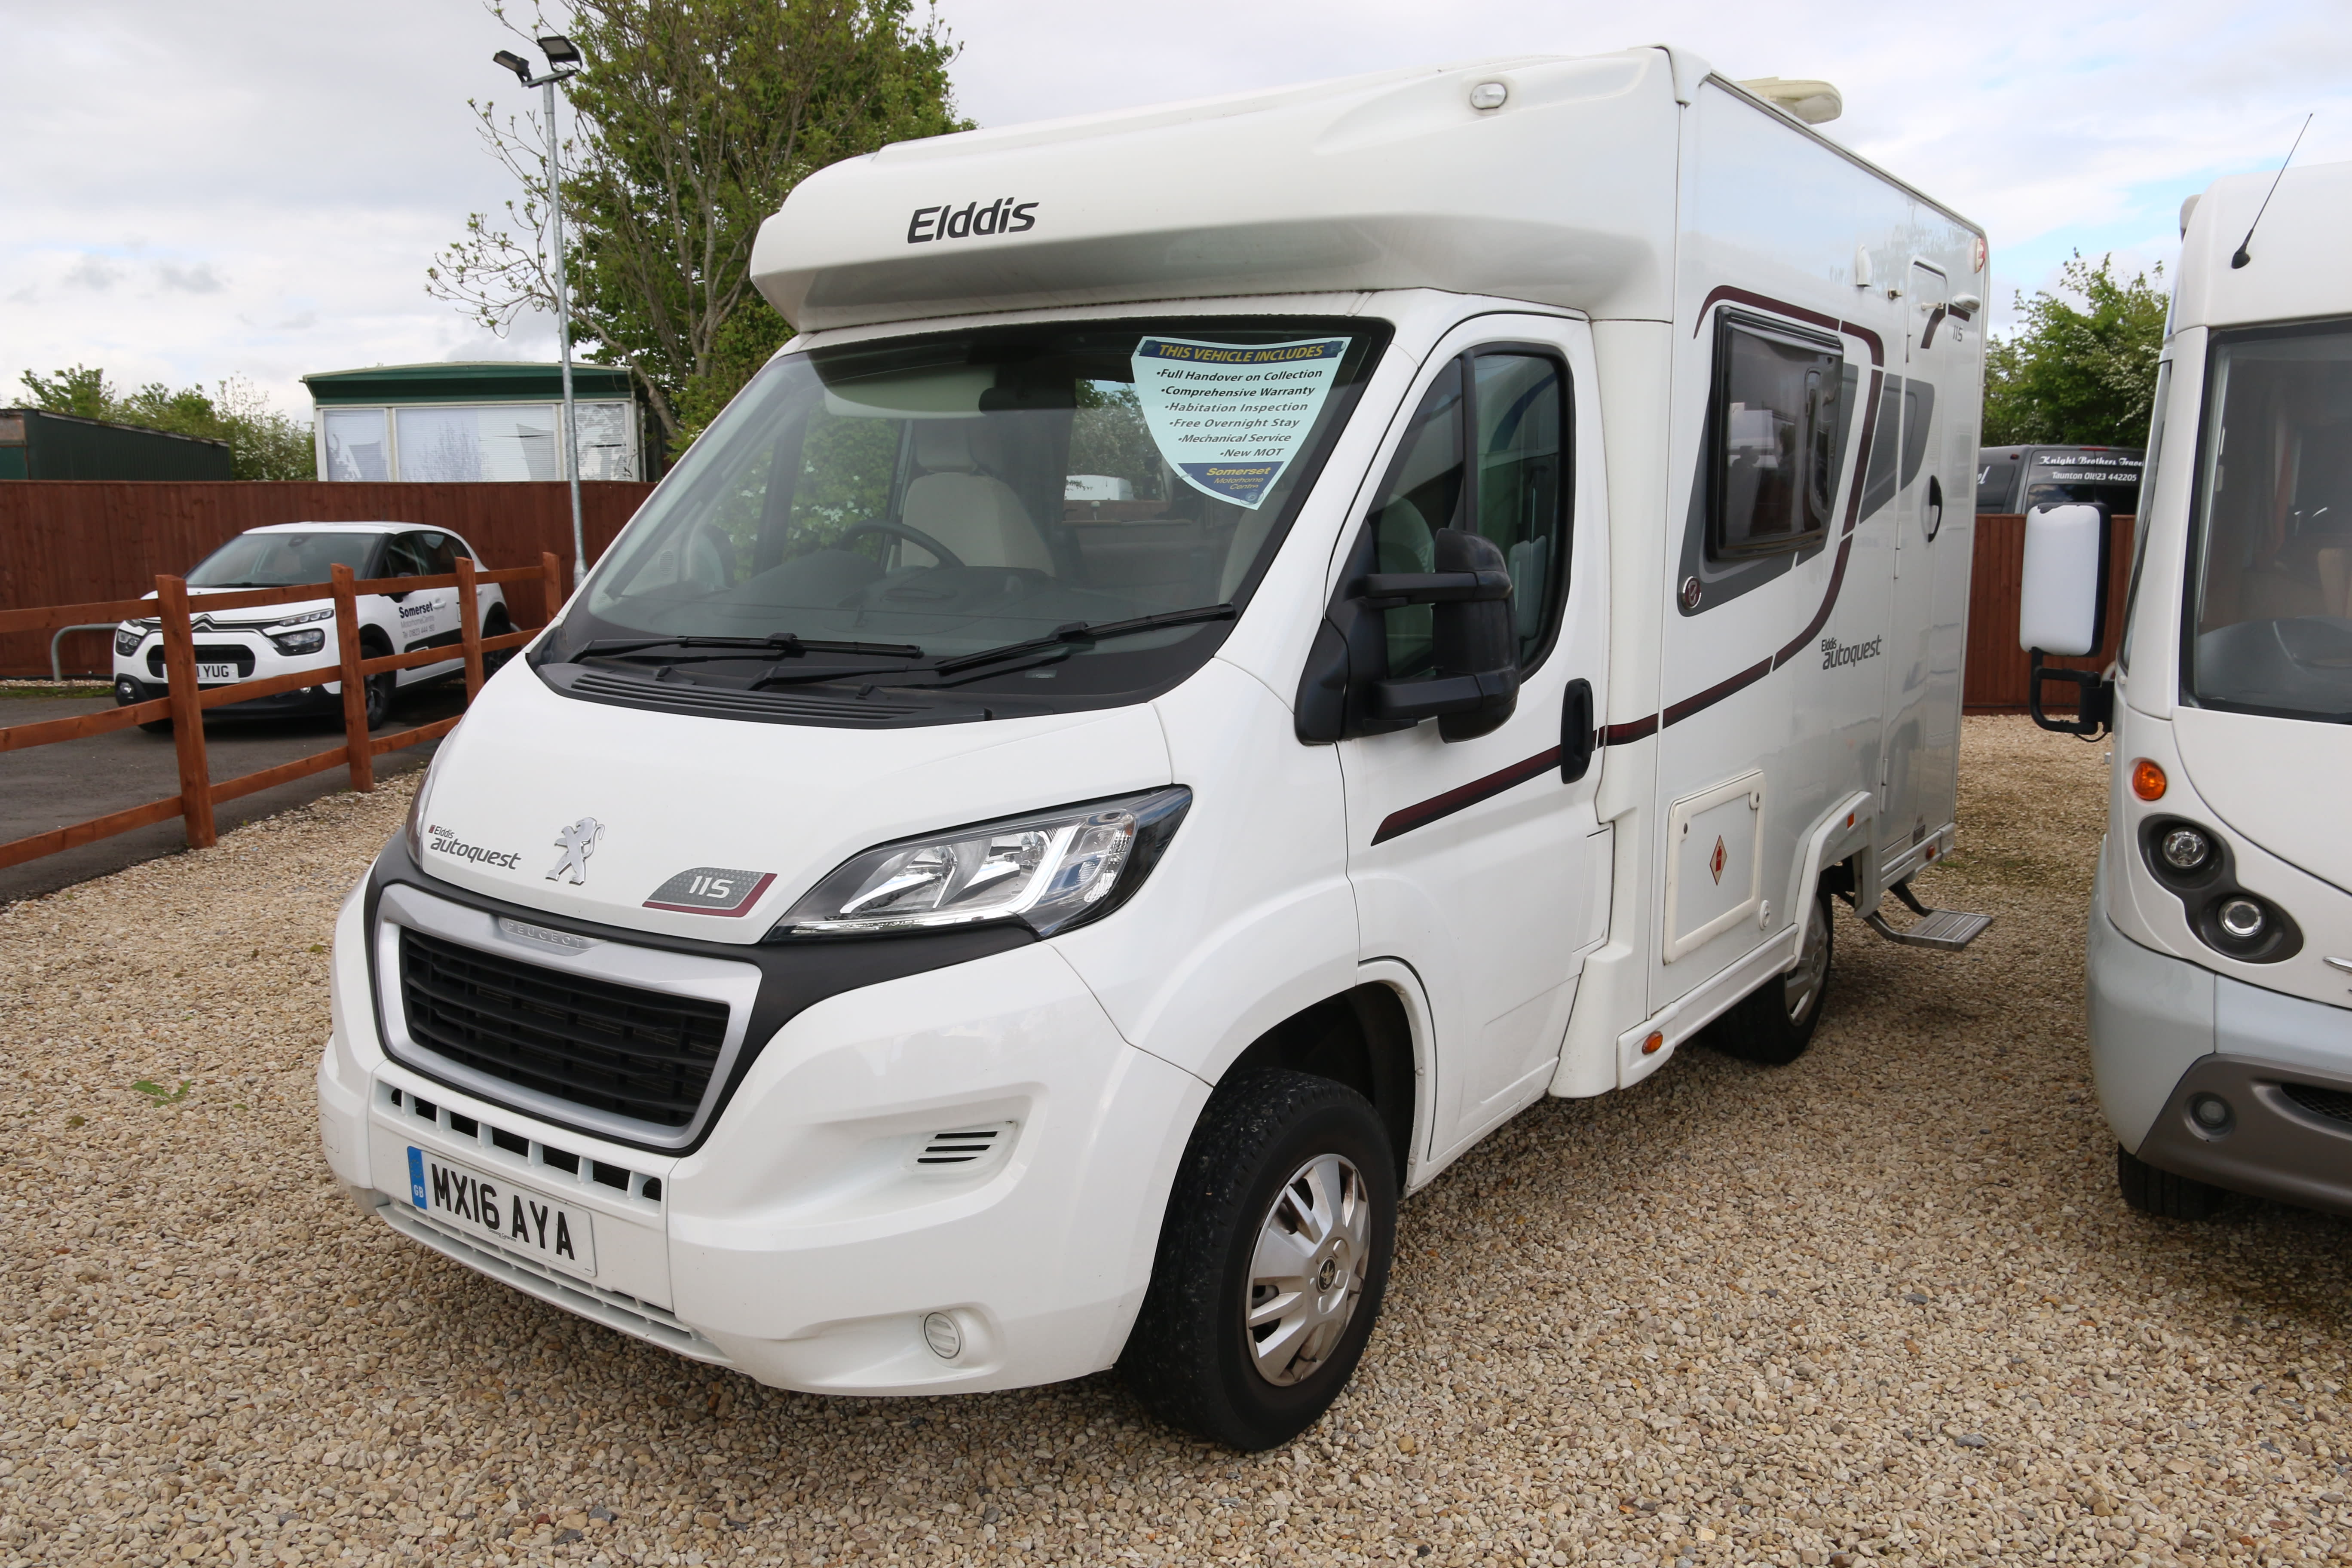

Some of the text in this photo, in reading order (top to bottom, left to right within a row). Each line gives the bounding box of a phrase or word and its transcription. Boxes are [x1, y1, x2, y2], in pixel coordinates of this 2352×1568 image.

[907, 197, 1039, 244] Elddis
[1953, 325, 1963, 342] 115
[1159, 345, 1324, 361] THIS VEHICLE INCLUDES
[1161, 369, 1183, 379] Full
[1185, 371, 1243, 381] Handover
[1264, 369, 1322, 380] Collection
[1166, 386, 1315, 398] Comprehensive Warranty
[1169, 402, 1308, 413] Habitation Inspection
[1173, 418, 1300, 429] Free Overnight Stay
[1181, 434, 1291, 442] Mechanical Service
[1224, 448, 1284, 457] New MOT
[2039, 456, 2075, 465] Knight
[2078, 456, 2116, 466] Brothers
[1207, 467, 1271, 475] Somerset
[2108, 473, 2137, 481] 442205
[399, 601, 433, 619] Somerset
[1822, 637, 1837, 652] Elddis
[1822, 634, 1882, 670] autoquest
[203, 665, 229, 677] YUG
[434, 826, 455, 839] Elddis
[430, 838, 521, 870] autoquest
[508, 922, 582, 947] PEUGEOT
[414, 1184, 424, 1198] GB
[432, 1163, 575, 1260] MX16 AYA
